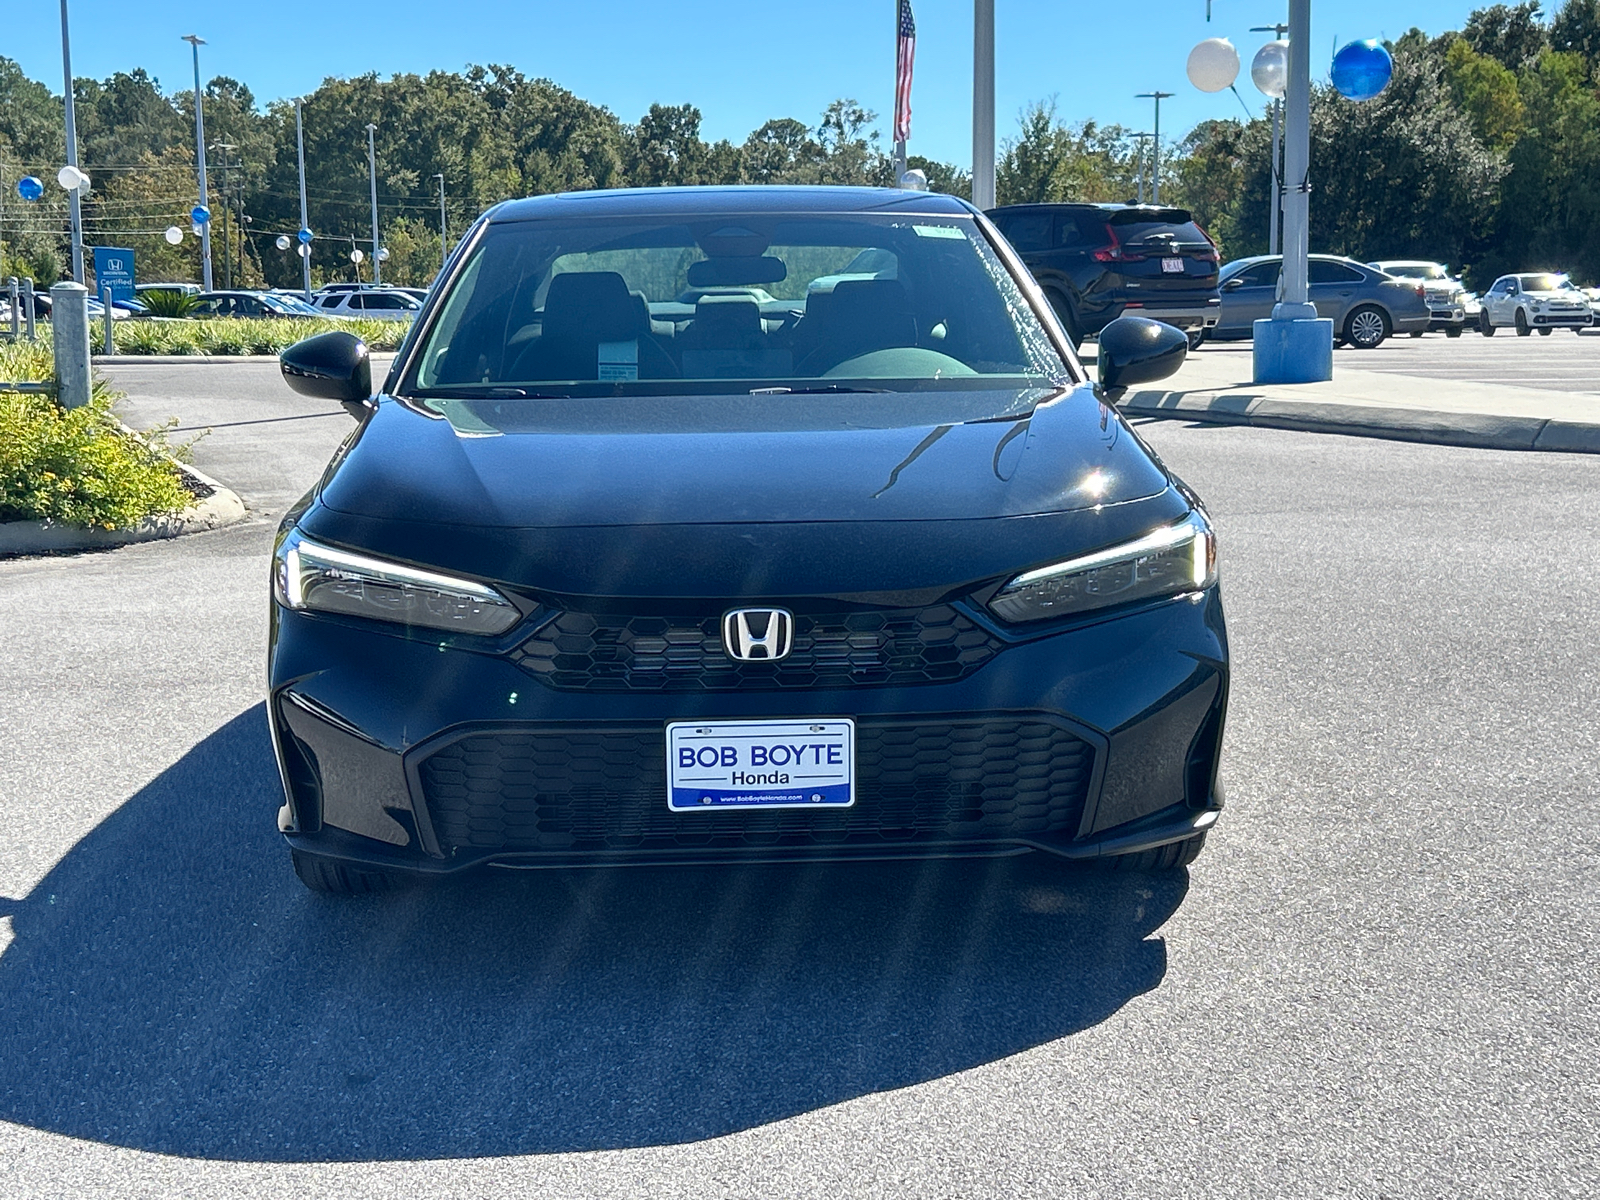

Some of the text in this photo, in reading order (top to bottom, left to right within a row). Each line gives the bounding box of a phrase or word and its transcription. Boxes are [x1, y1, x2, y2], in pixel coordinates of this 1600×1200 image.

[679, 744, 843, 768] BOB BOYTE
[732, 770, 790, 785] Honda
